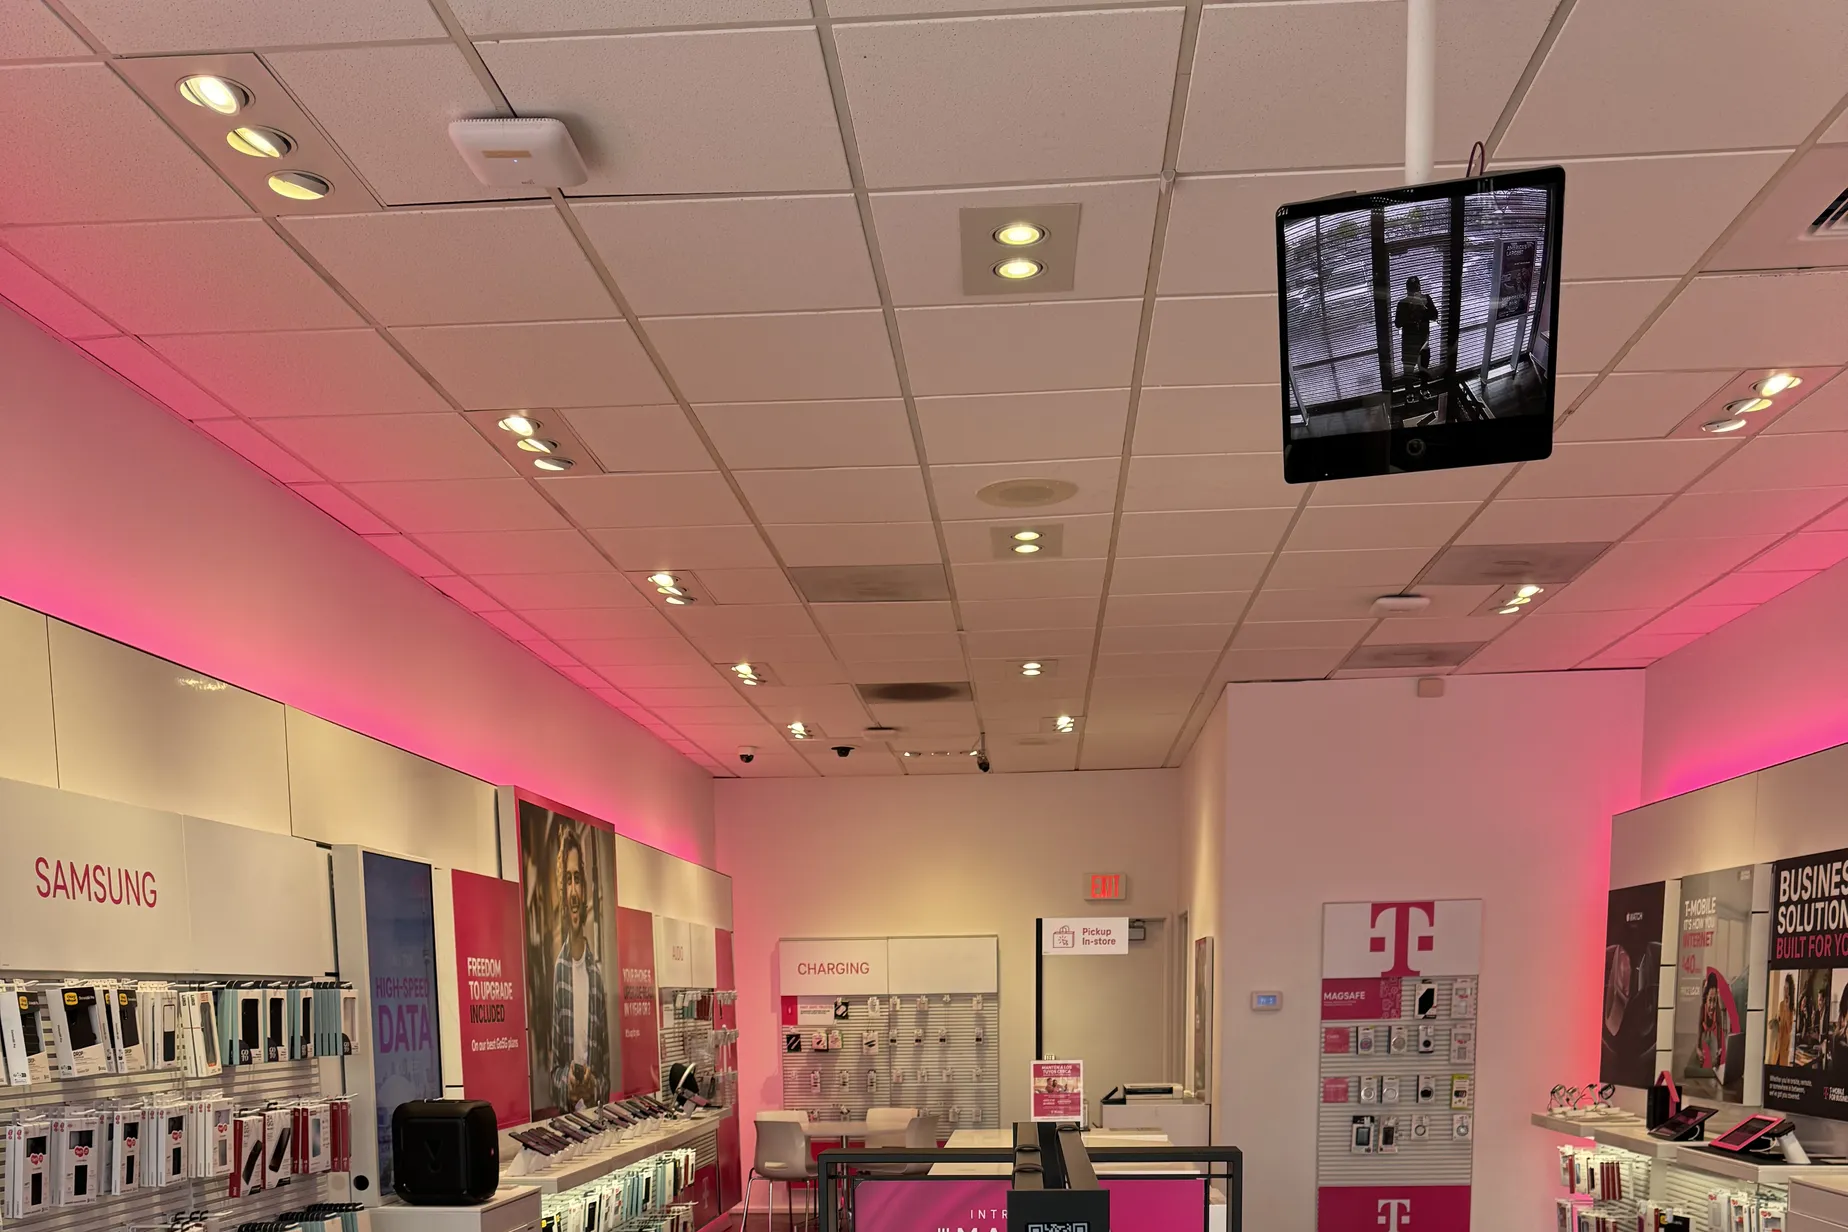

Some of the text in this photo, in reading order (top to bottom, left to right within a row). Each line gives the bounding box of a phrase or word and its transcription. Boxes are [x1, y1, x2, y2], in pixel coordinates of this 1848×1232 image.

[35, 857, 157, 908] SAMSUNG
[1091, 874, 1120, 898] EXIT
[1684, 897, 1717, 917] T-MOBILE
[1082, 928, 1112, 936] Pickup
[1704, 916, 1715, 929] YOU
[1682, 931, 1714, 949] INTERNET
[1776, 936, 1807, 959] BUILT
[1808, 934, 1832, 957] FOR
[467, 957, 502, 977] FREEDOM
[797, 962, 870, 975] CHARGING
[375, 976, 430, 999] HIGH-SPEED
[468, 981, 513, 1000] TO UPGRADE
[1323, 991, 1366, 1000] MAGSAFE
[470, 1004, 505, 1024] INCLUDED
[378, 1004, 434, 1054] DATA
[471, 1039, 478, 1052] On
[486, 1039, 496, 1050] best
[508, 1037, 518, 1051] plans
